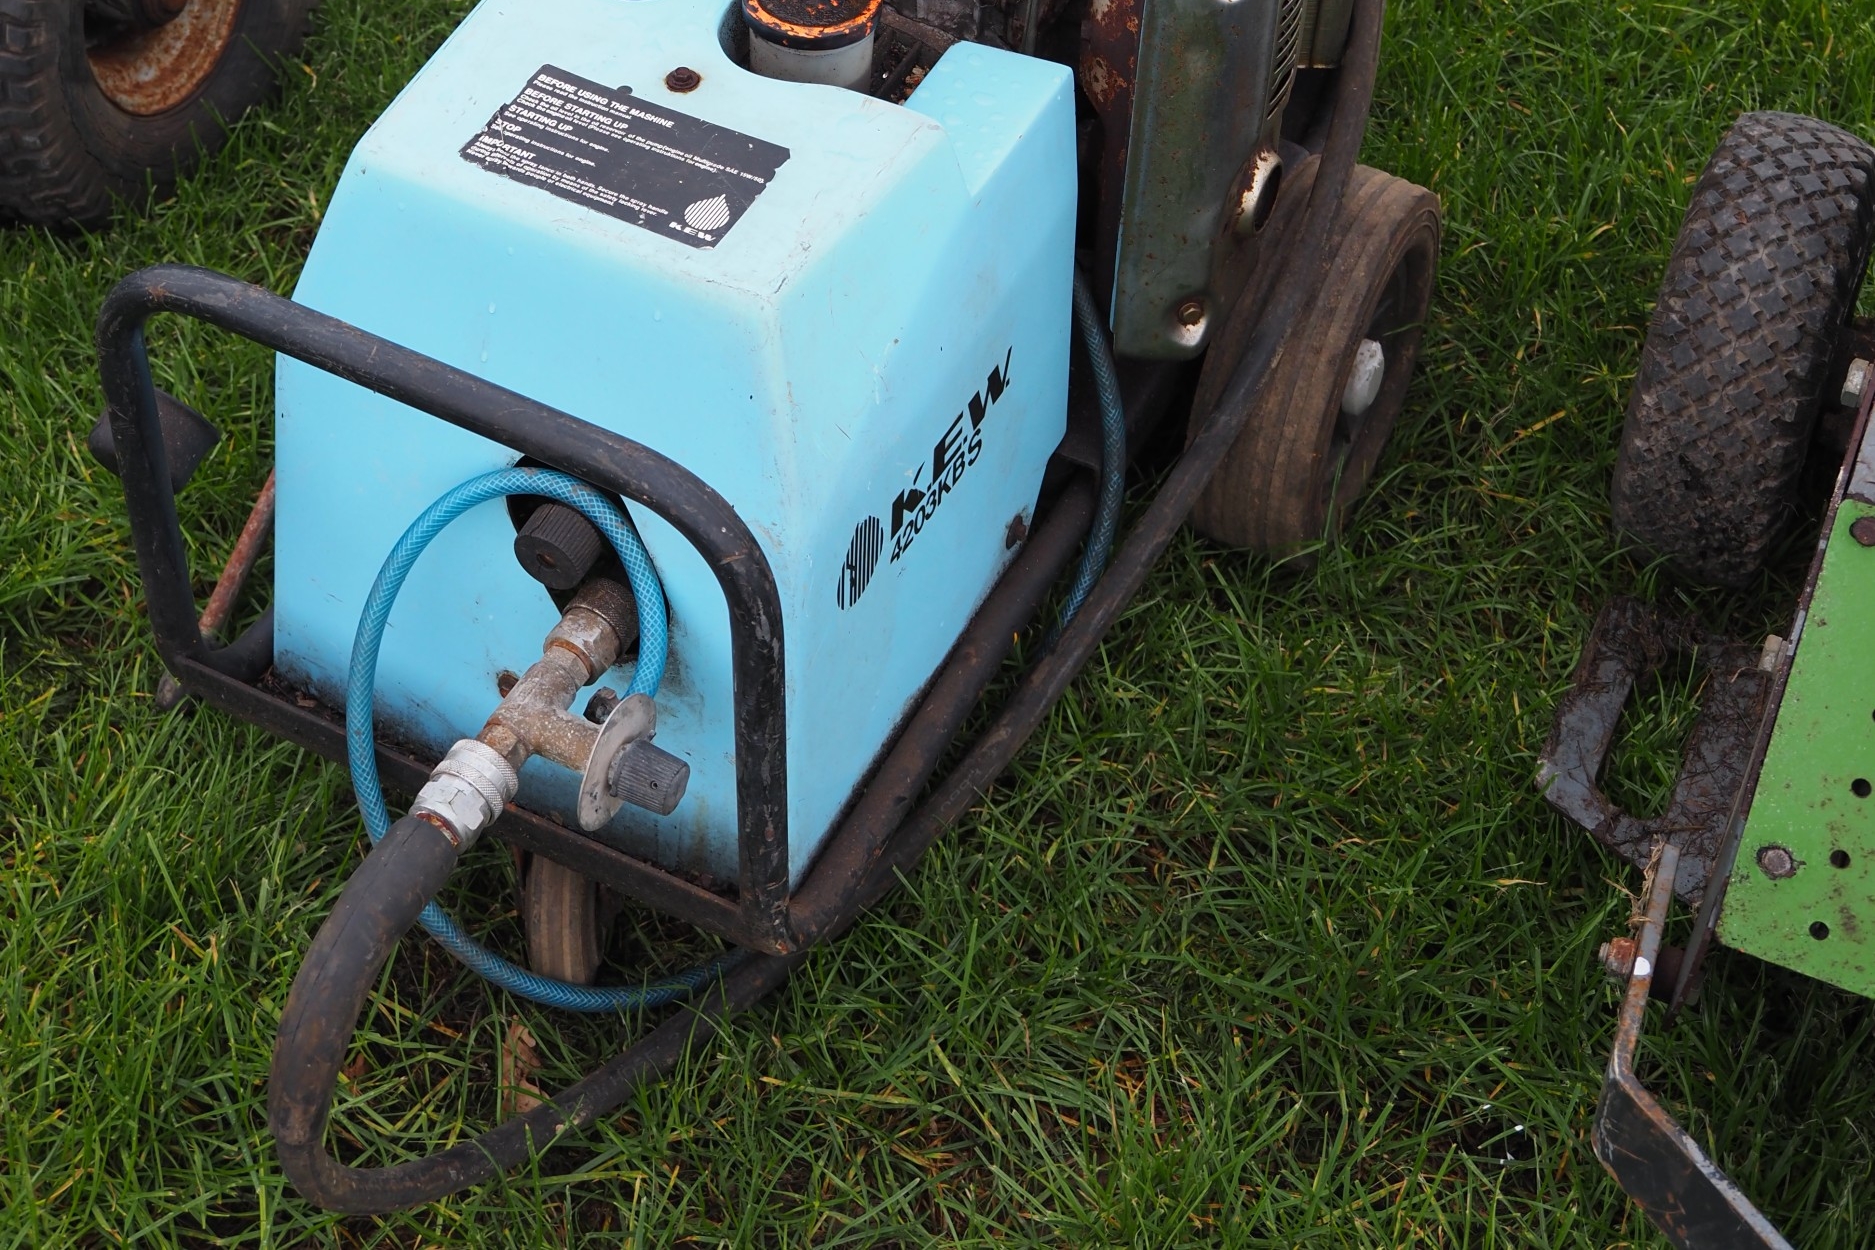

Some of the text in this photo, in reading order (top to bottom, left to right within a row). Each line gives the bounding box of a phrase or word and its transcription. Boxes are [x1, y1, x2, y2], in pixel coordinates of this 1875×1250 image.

[520, 94, 539, 104] Check
[558, 108, 574, 117] level
[533, 80, 553, 91] Please
[553, 88, 569, 96] read
[578, 98, 609, 111] instruction
[537, 74, 674, 128] BEFORE USING THE MASHINE
[508, 105, 573, 131] STARTING UP
[516, 98, 536, 108] Check
[572, 118, 589, 127] level
[524, 88, 629, 129] BEFORE STARTING UP
[494, 118, 522, 132] STOP
[516, 116, 545, 130] operating
[545, 126, 579, 141] instructions
[479, 135, 536, 159] IMPORTANT
[531, 140, 565, 155] instructions
[521, 159, 538, 168] spray
[597, 186, 618, 196] Secure
[629, 198, 647, 208] spray
[647, 204, 669, 215] handle
[599, 192, 618, 202] safety
[669, 221, 716, 241] KEW
[890, 428, 983, 565] 4203KBS
